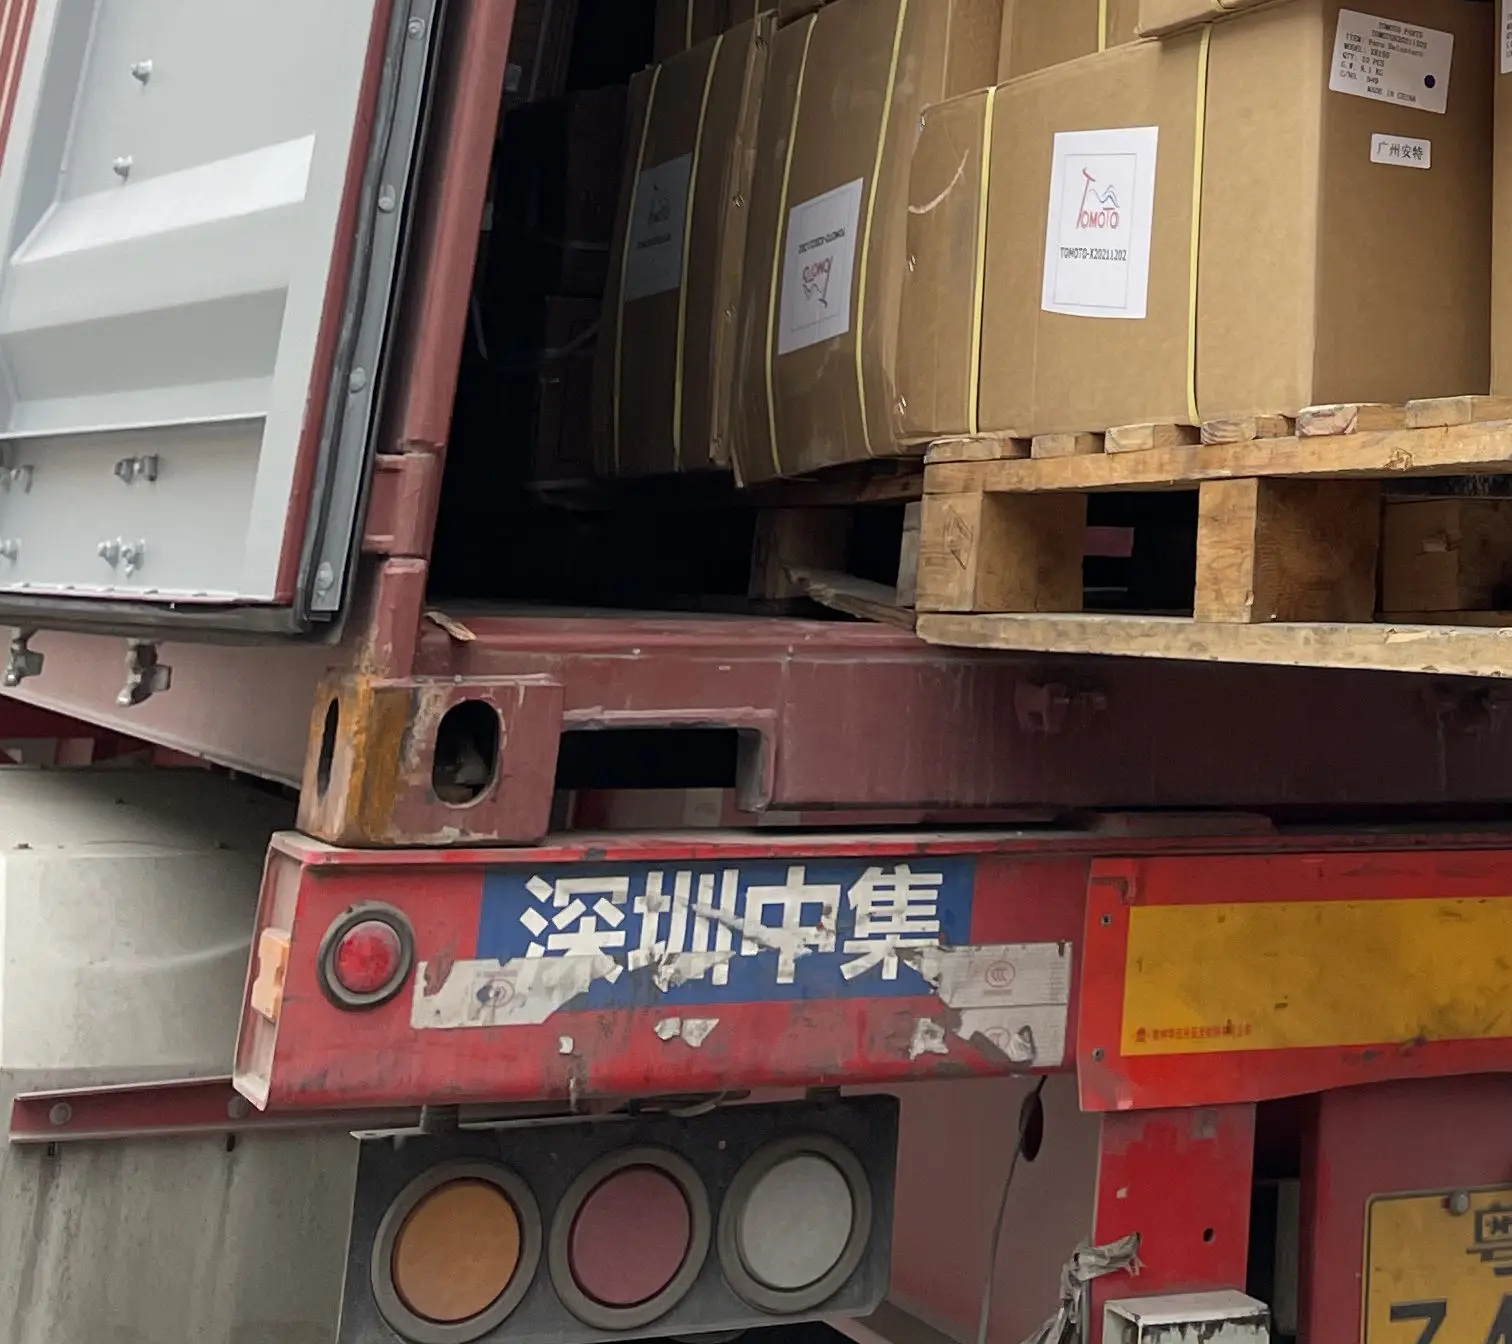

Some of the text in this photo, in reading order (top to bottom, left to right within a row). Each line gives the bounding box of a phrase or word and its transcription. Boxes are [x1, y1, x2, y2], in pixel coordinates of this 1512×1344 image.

[1376, 141, 1424, 161] 广州安特
[1076, 167, 1120, 230] TOMOTO
[1060, 246, 1128, 262] TOMOTO-X20211202
[519, 864, 946, 988] 深圳中集
